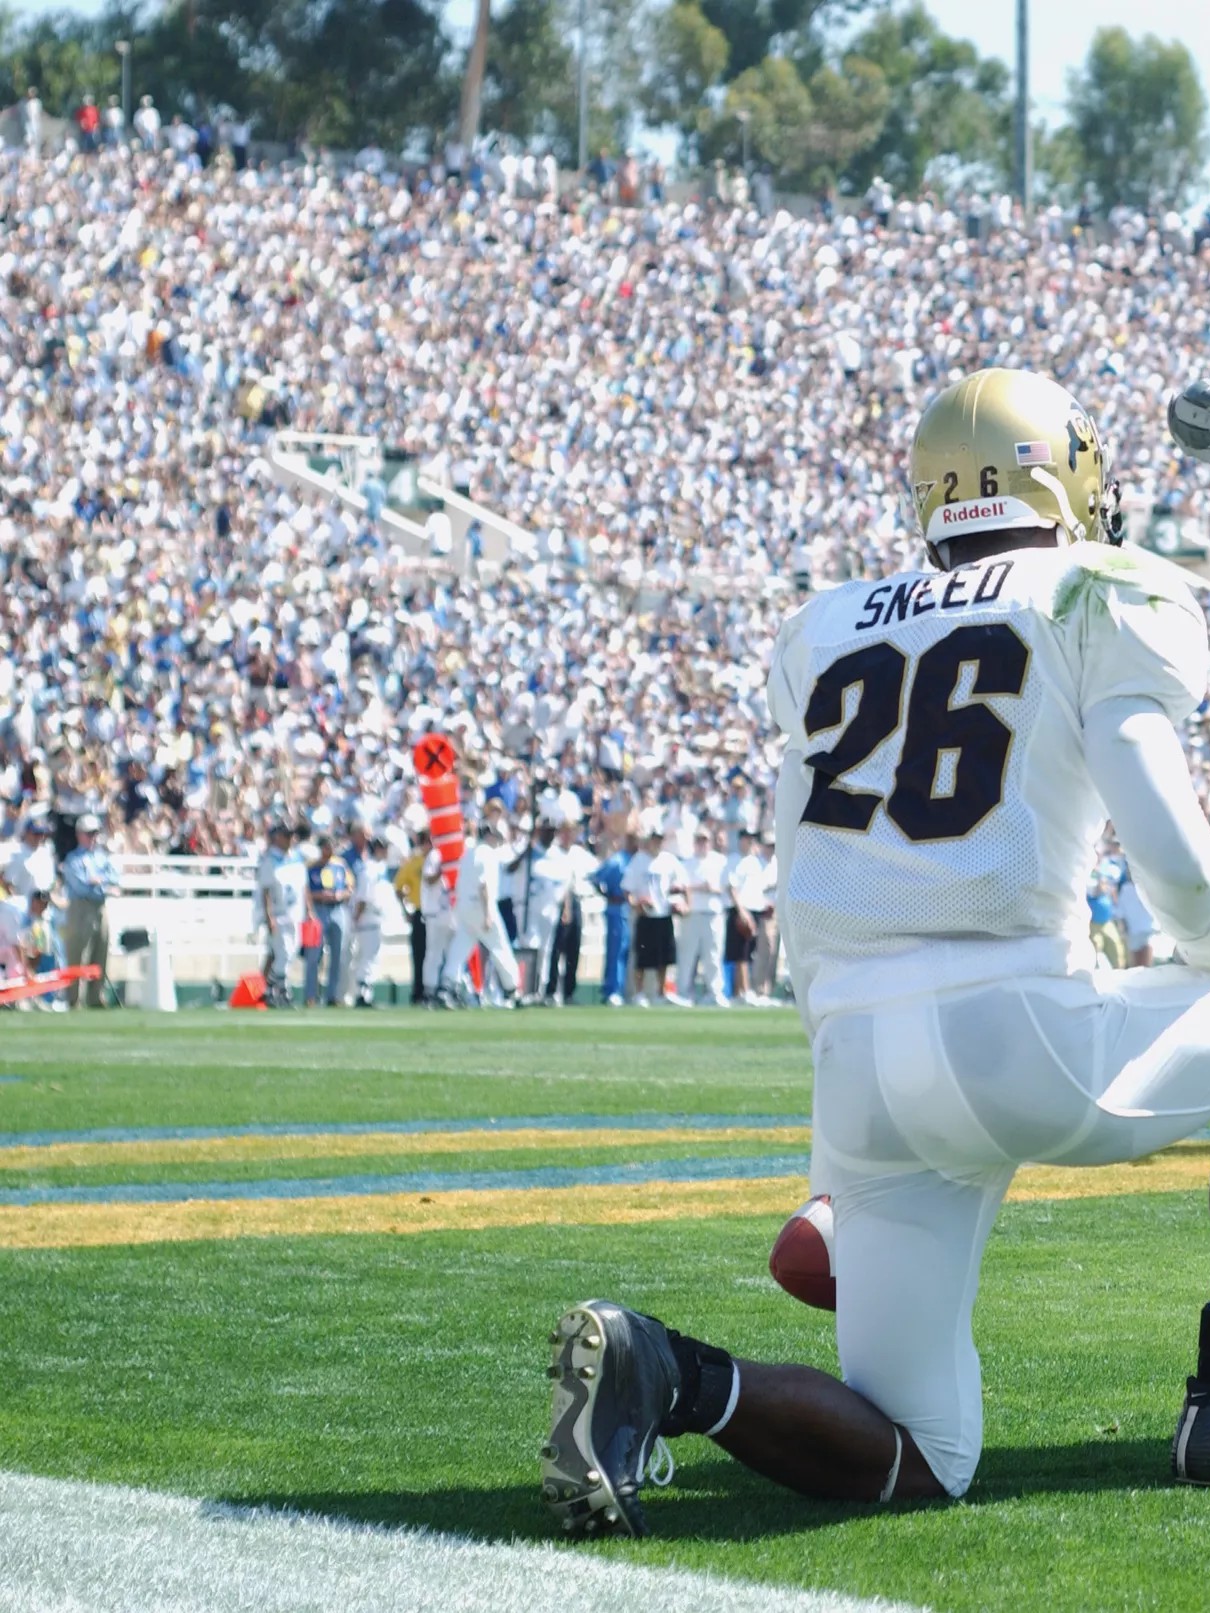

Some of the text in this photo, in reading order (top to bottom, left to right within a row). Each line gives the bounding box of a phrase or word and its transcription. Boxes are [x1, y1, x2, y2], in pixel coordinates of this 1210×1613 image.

[387, 467, 416, 504] 4
[943, 471, 960, 505] 2
[980, 465, 999, 498] 6
[943, 502, 1006, 524] Riddell
[1155, 519, 1179, 551] 3
[855, 560, 1014, 630] SNEED
[799, 622, 1032, 843] 26
